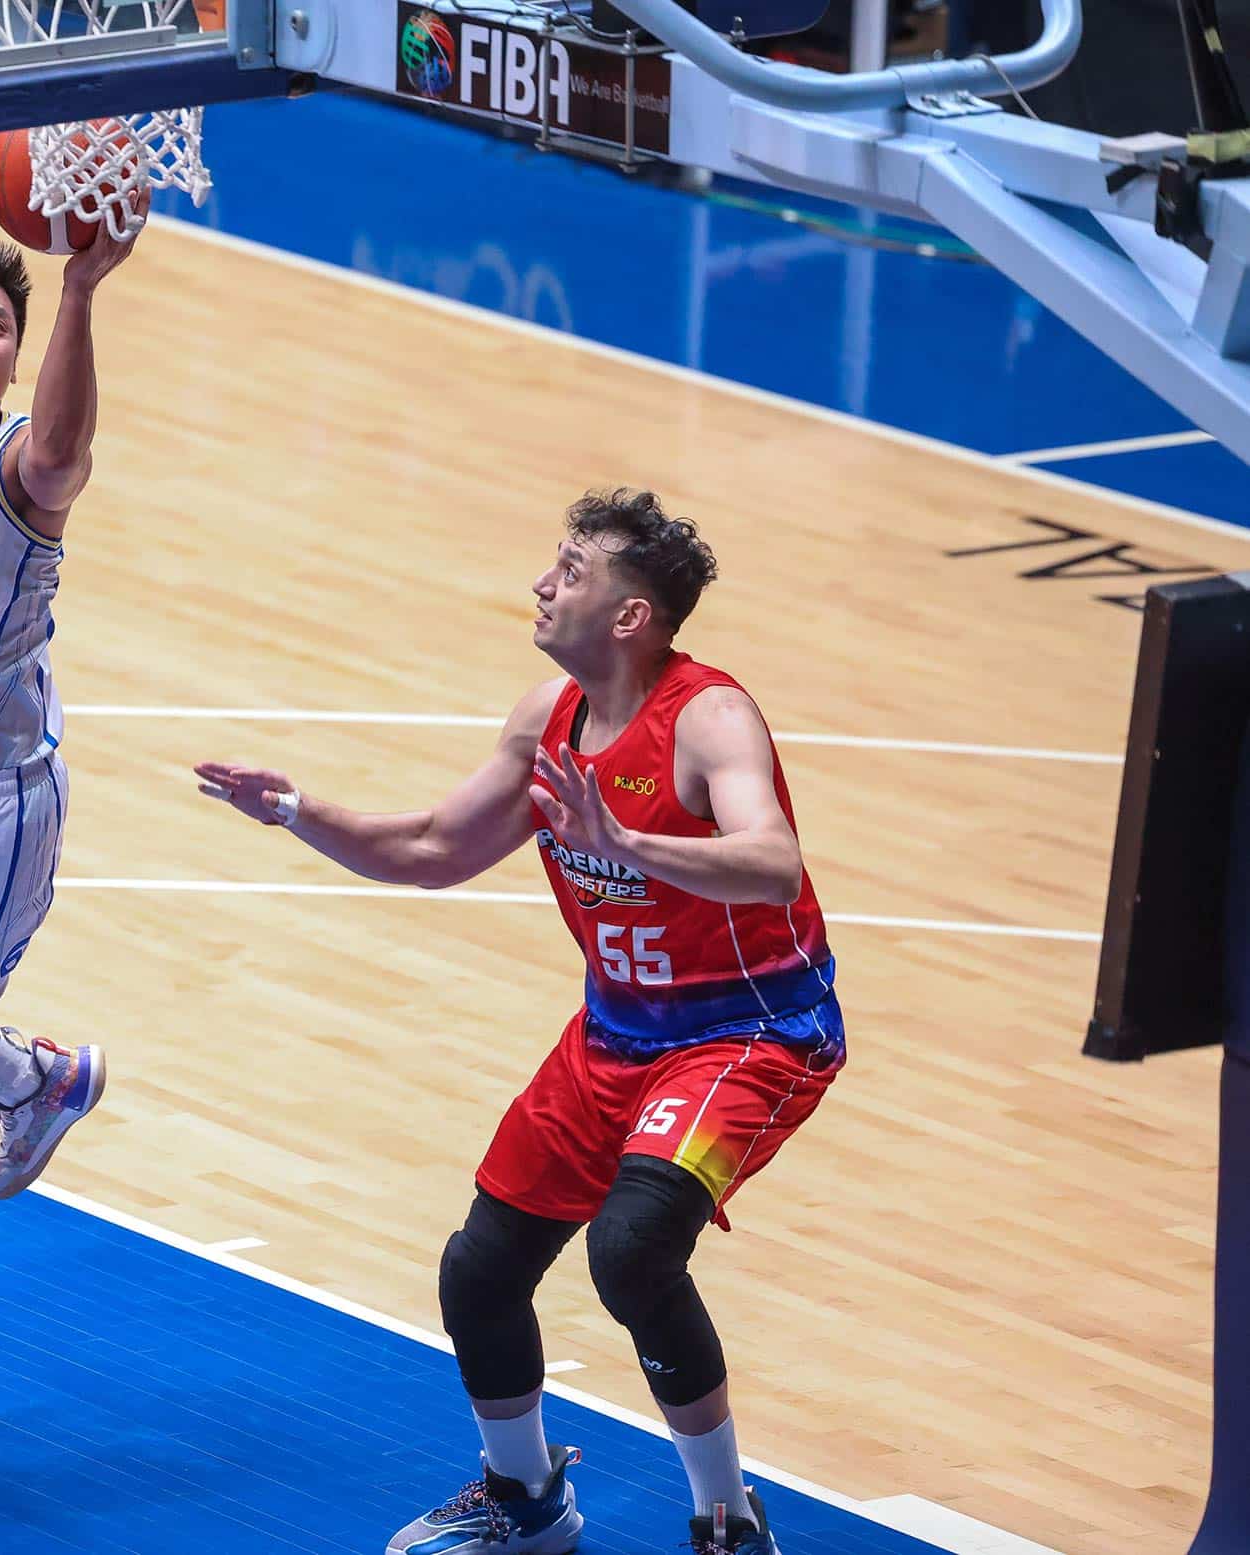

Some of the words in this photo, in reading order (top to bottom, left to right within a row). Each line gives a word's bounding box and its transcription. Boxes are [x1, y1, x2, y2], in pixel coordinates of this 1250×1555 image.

[460, 22, 570, 126] FIBA
[570, 73, 589, 96] We
[597, 922, 673, 986] 55
